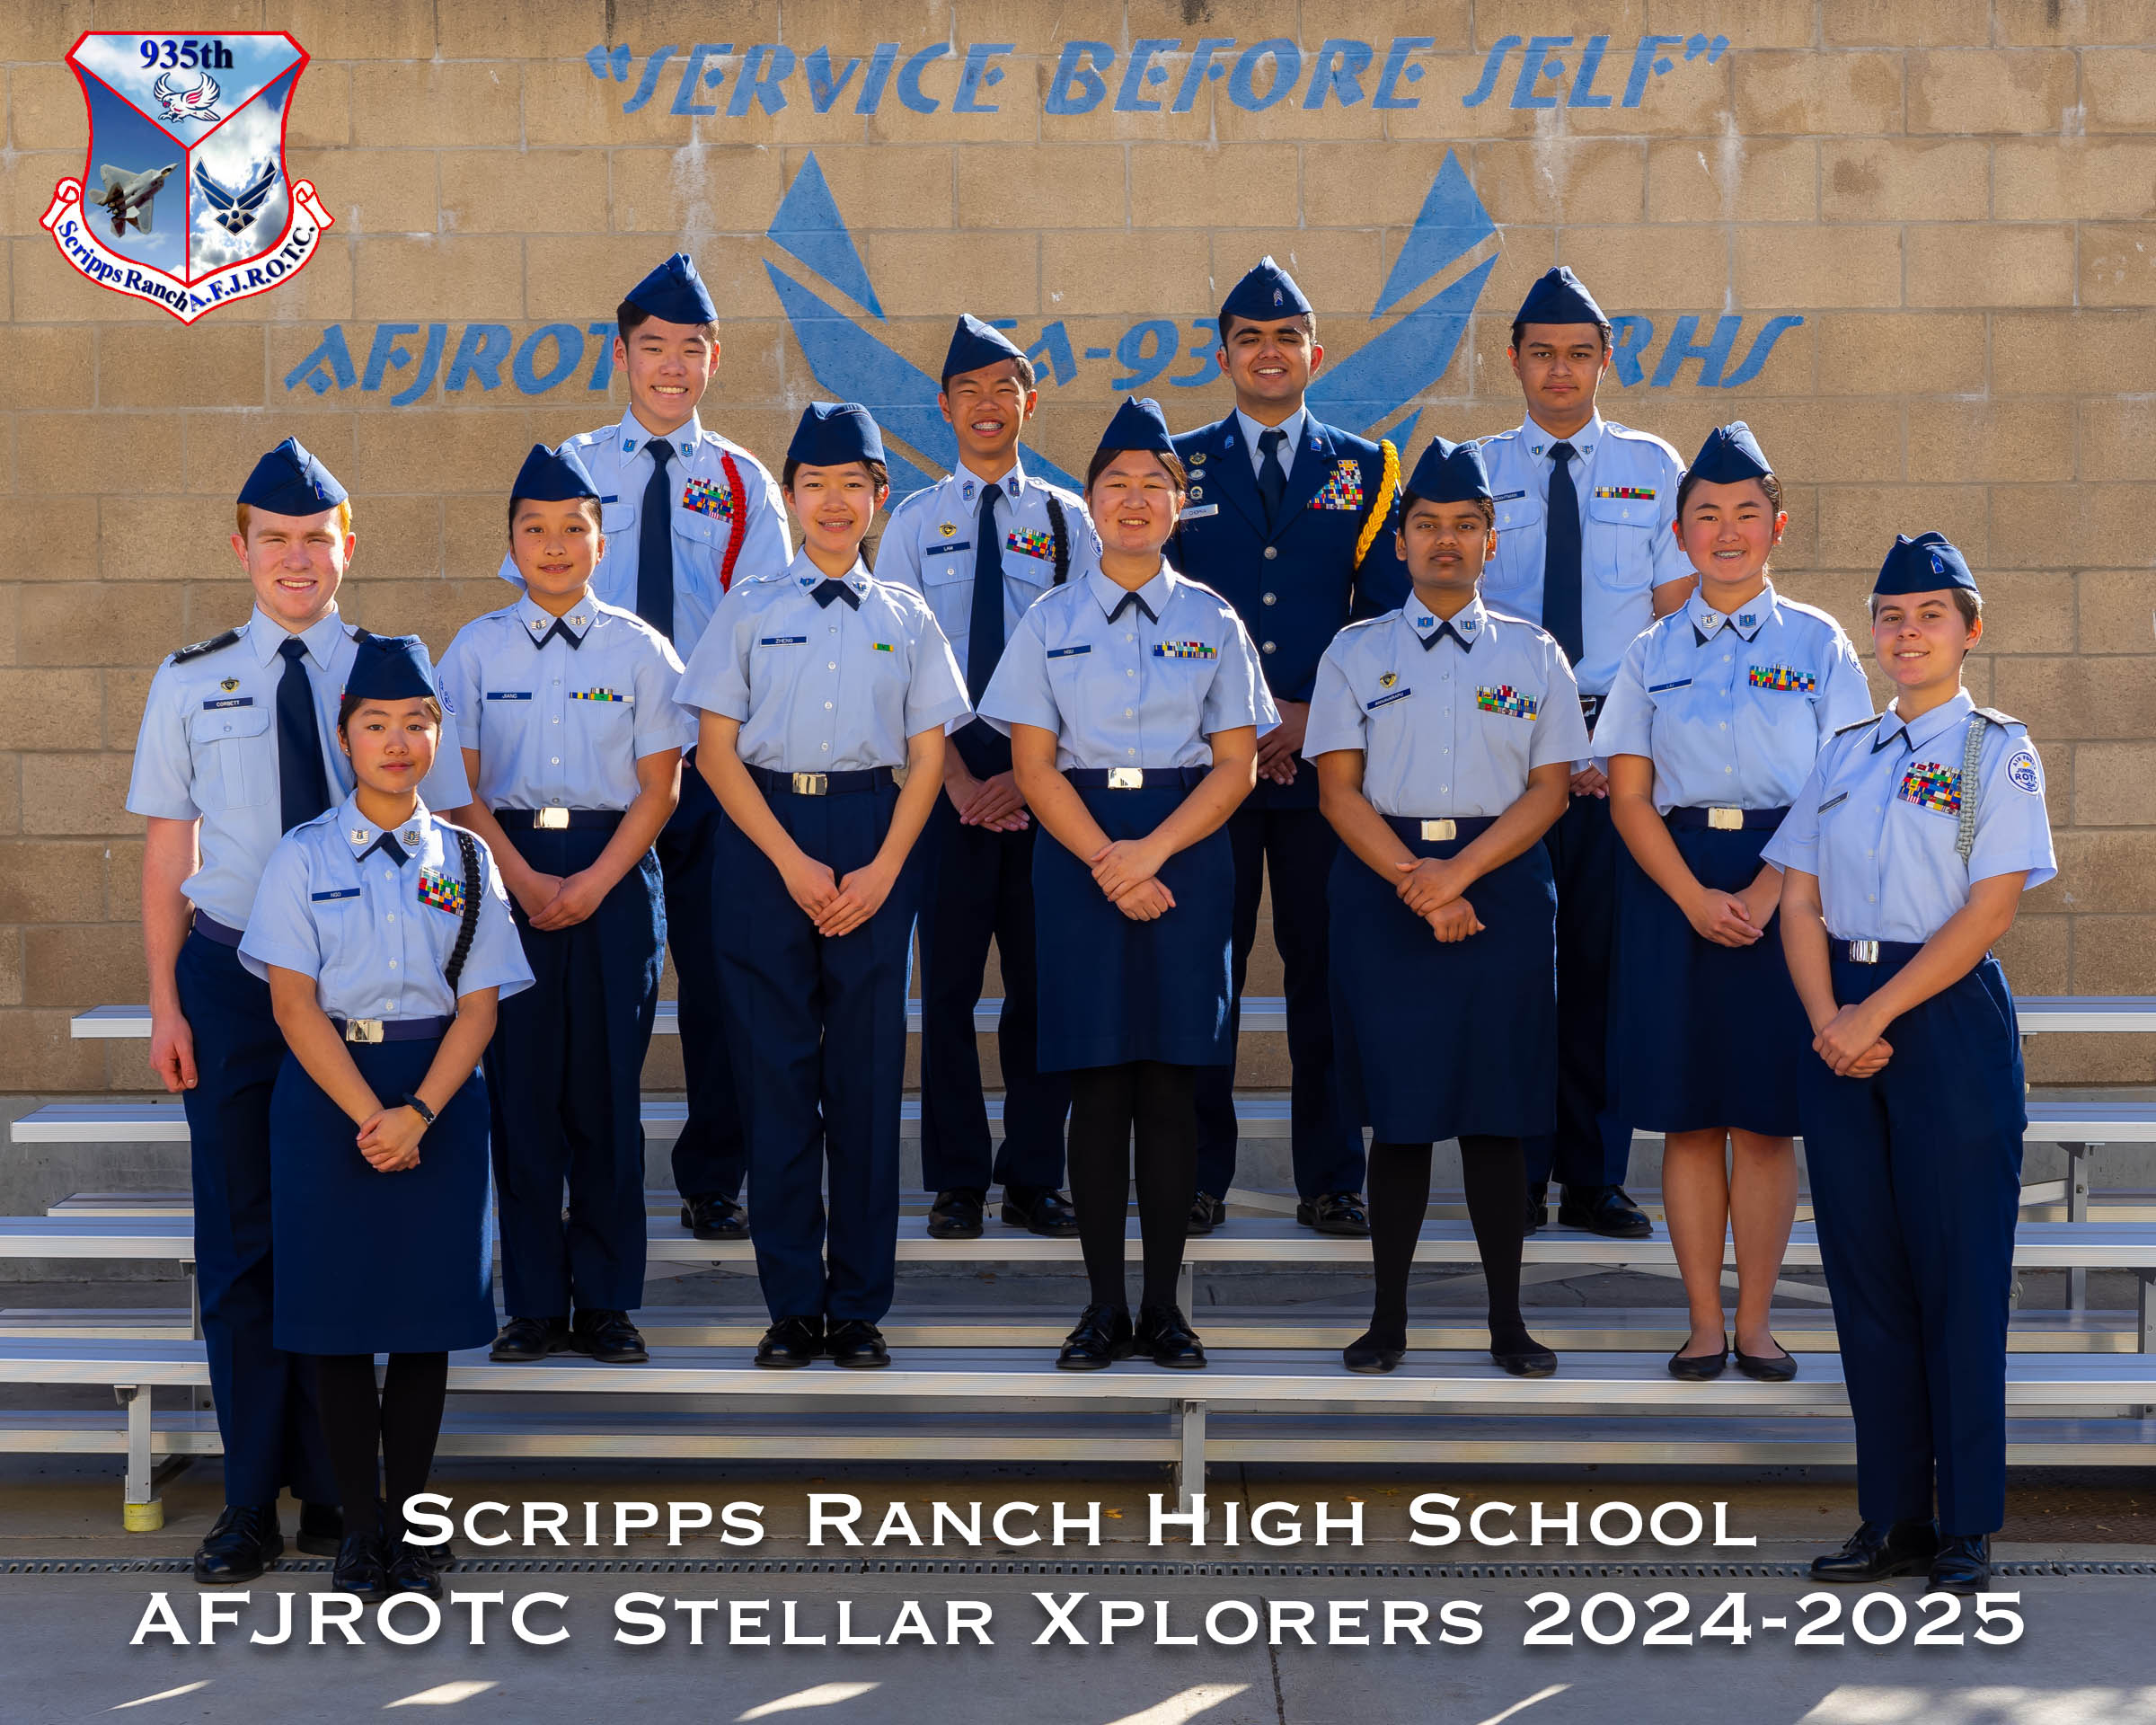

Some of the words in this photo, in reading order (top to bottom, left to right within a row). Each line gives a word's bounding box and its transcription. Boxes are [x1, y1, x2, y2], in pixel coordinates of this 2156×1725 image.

[1045, 37, 1436, 115] BEFORE
[283, 323, 620, 407] AFJROT
[986, 317, 1224, 392] A-93
[1599, 314, 1804, 389] RHS
[216, 700, 240, 708] CORBETT
